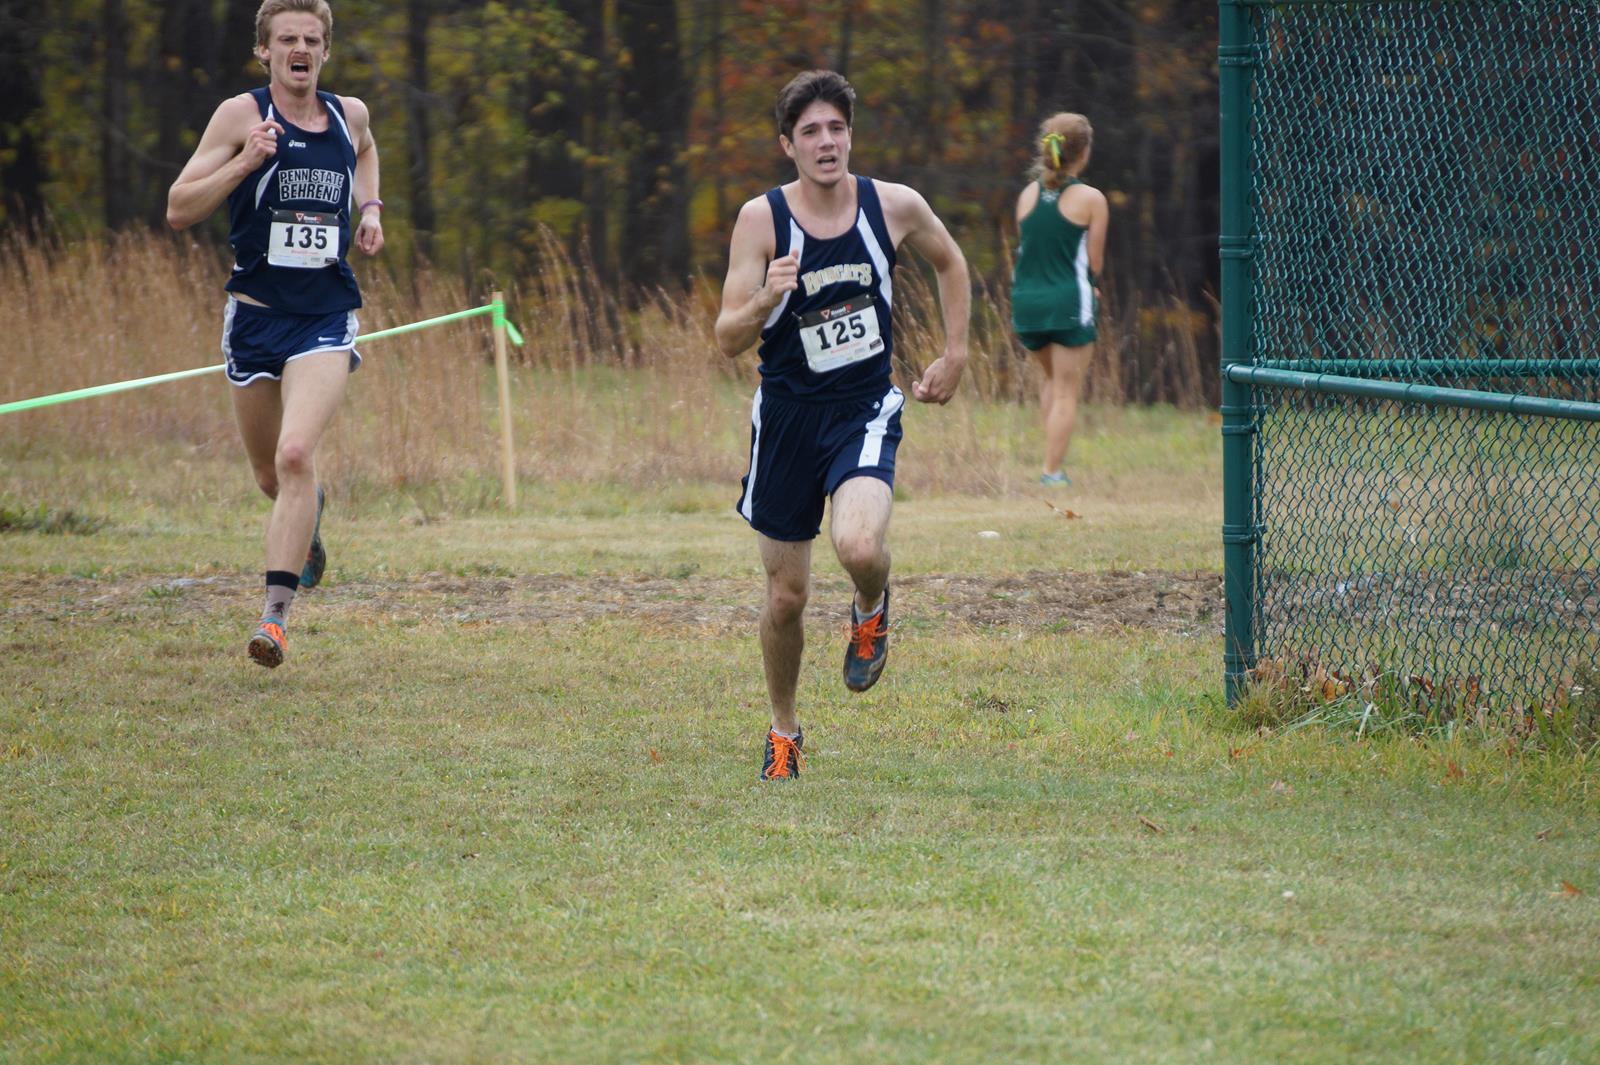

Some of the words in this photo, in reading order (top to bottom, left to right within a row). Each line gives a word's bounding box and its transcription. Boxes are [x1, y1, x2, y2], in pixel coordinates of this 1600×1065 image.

[279, 168, 310, 184] PENN
[311, 168, 345, 187] STATE
[279, 182, 342, 204] BEHREND
[284, 225, 327, 249] 135
[816, 315, 866, 350] 125
